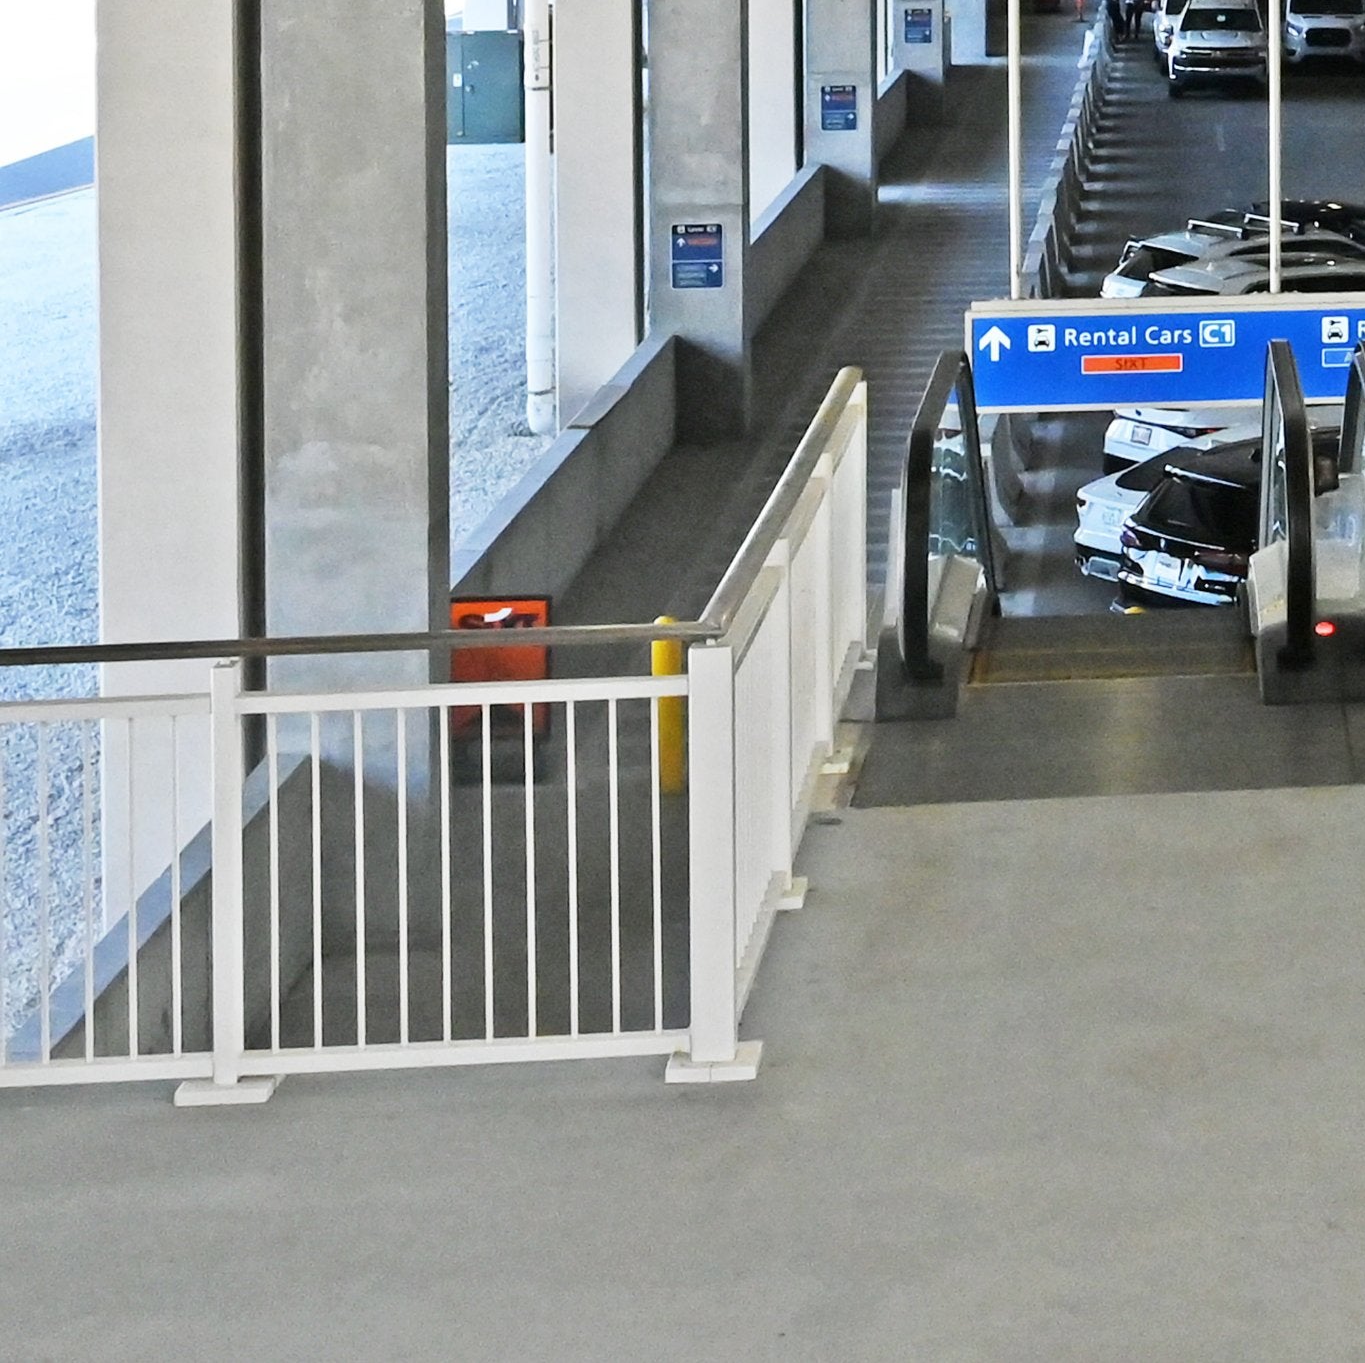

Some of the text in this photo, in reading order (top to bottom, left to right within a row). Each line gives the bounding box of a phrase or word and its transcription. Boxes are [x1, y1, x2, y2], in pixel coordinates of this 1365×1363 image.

[1064, 324, 1232, 347] Rental Cars C1
[1115, 357, 1148, 371] SIXT
